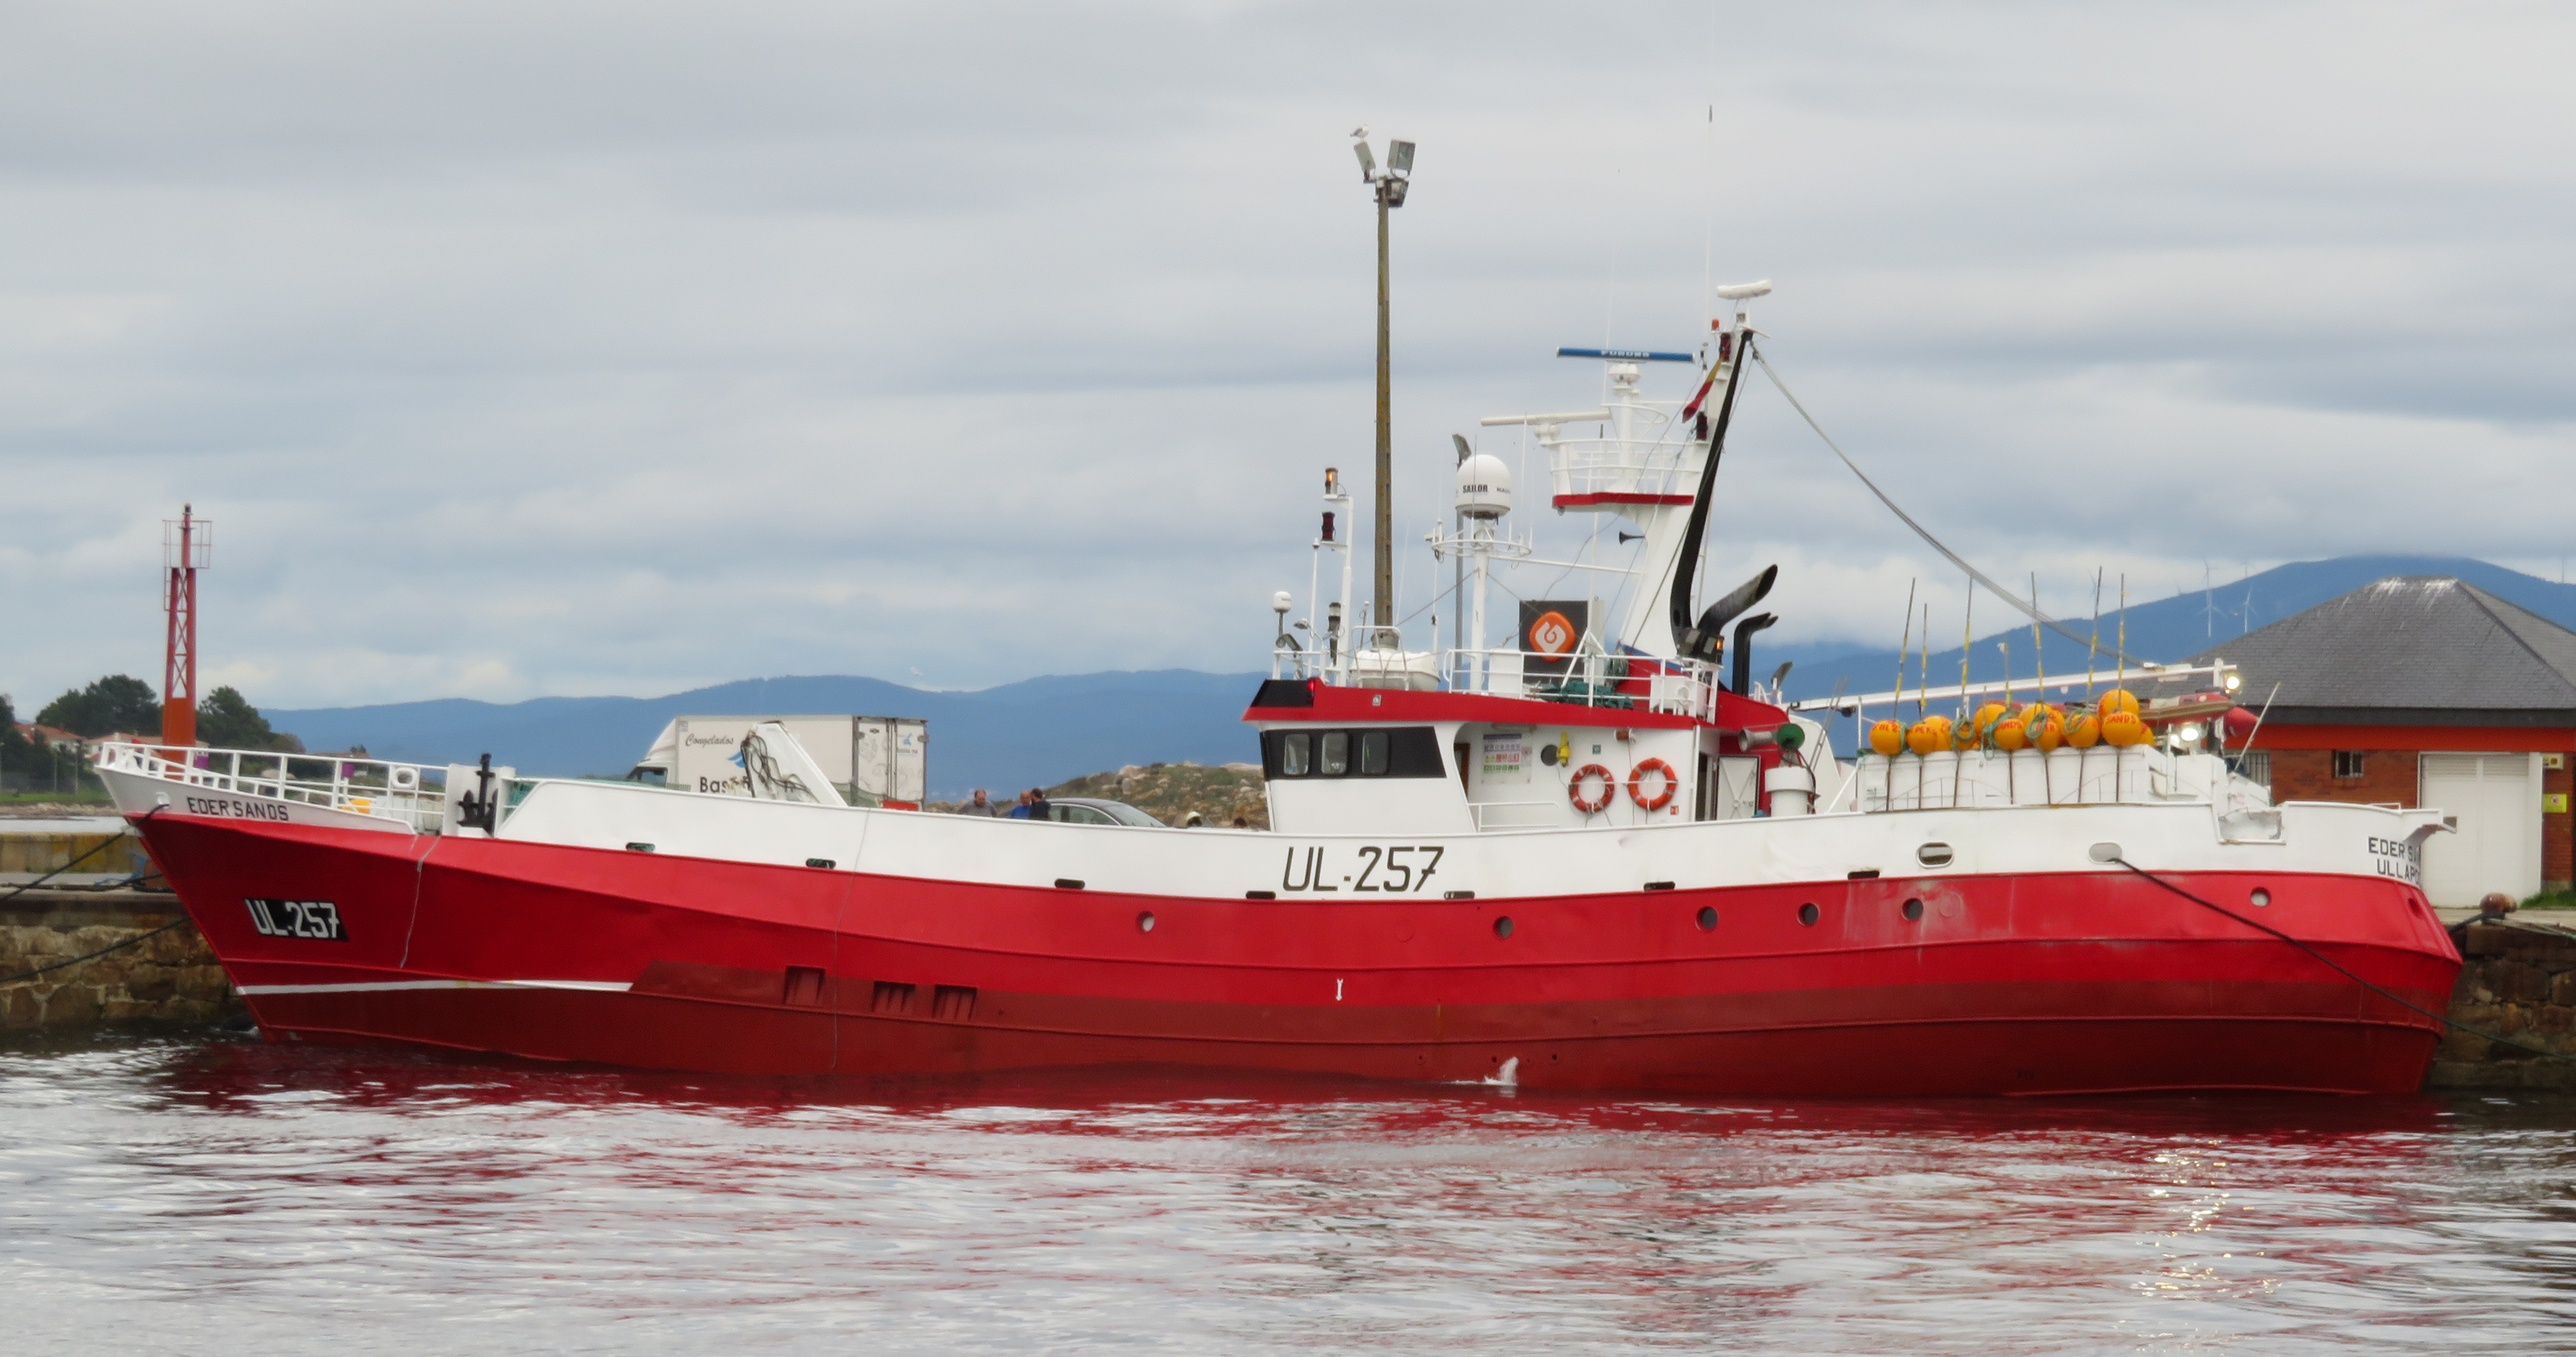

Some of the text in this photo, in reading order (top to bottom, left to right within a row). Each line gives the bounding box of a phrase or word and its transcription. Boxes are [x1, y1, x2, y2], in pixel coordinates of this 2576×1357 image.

[1601, 350, 1650, 358] FURUNO
[1462, 484, 1488, 493] SAILOR
[685, 733, 734, 748] Congelados
[186, 797, 289, 821] EDER SANDS
[2368, 836, 2405, 859] EDER
[1282, 845, 1444, 893] UL-257
[244, 898, 340, 939] UL-257
